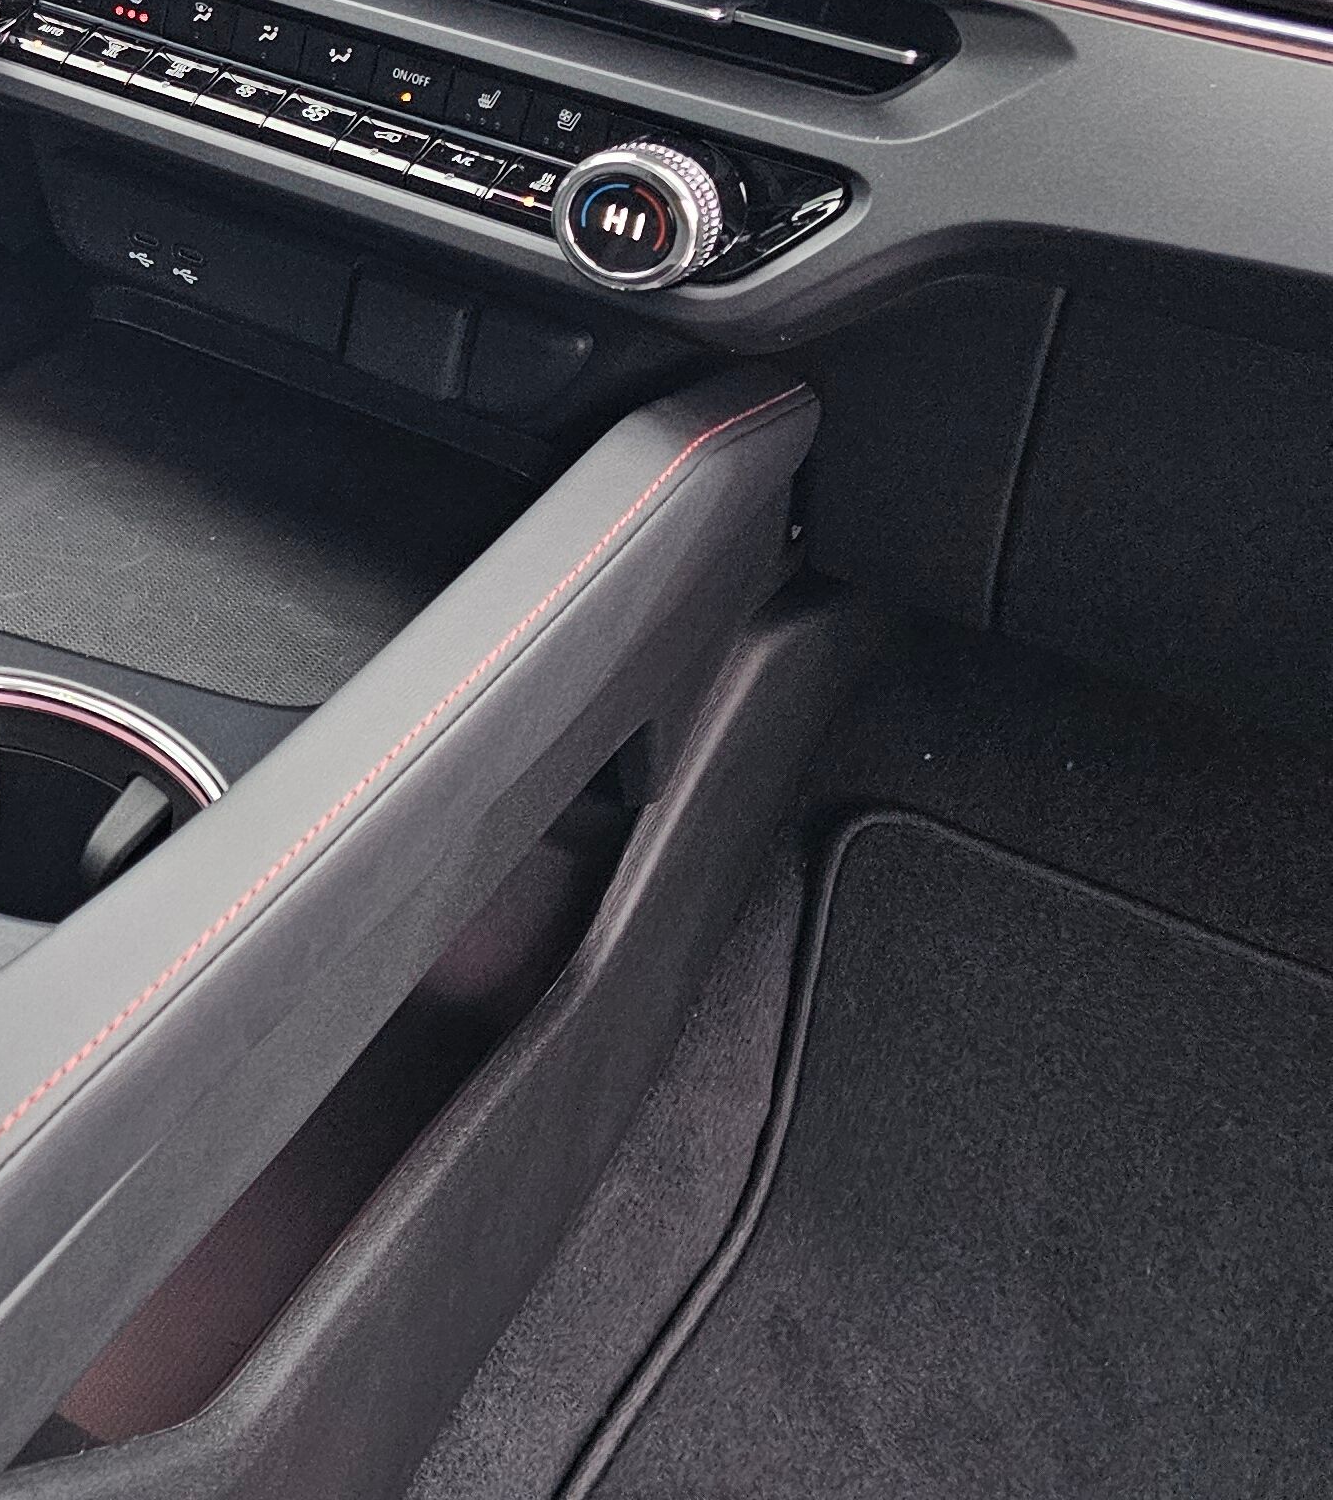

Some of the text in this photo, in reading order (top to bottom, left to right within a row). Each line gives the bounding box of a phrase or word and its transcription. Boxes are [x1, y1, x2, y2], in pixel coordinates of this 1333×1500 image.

[37, 24, 64, 37] AUTO
[392, 67, 431, 88] ON/OFF
[451, 153, 476, 167] A/C
[602, 203, 646, 241] HI
